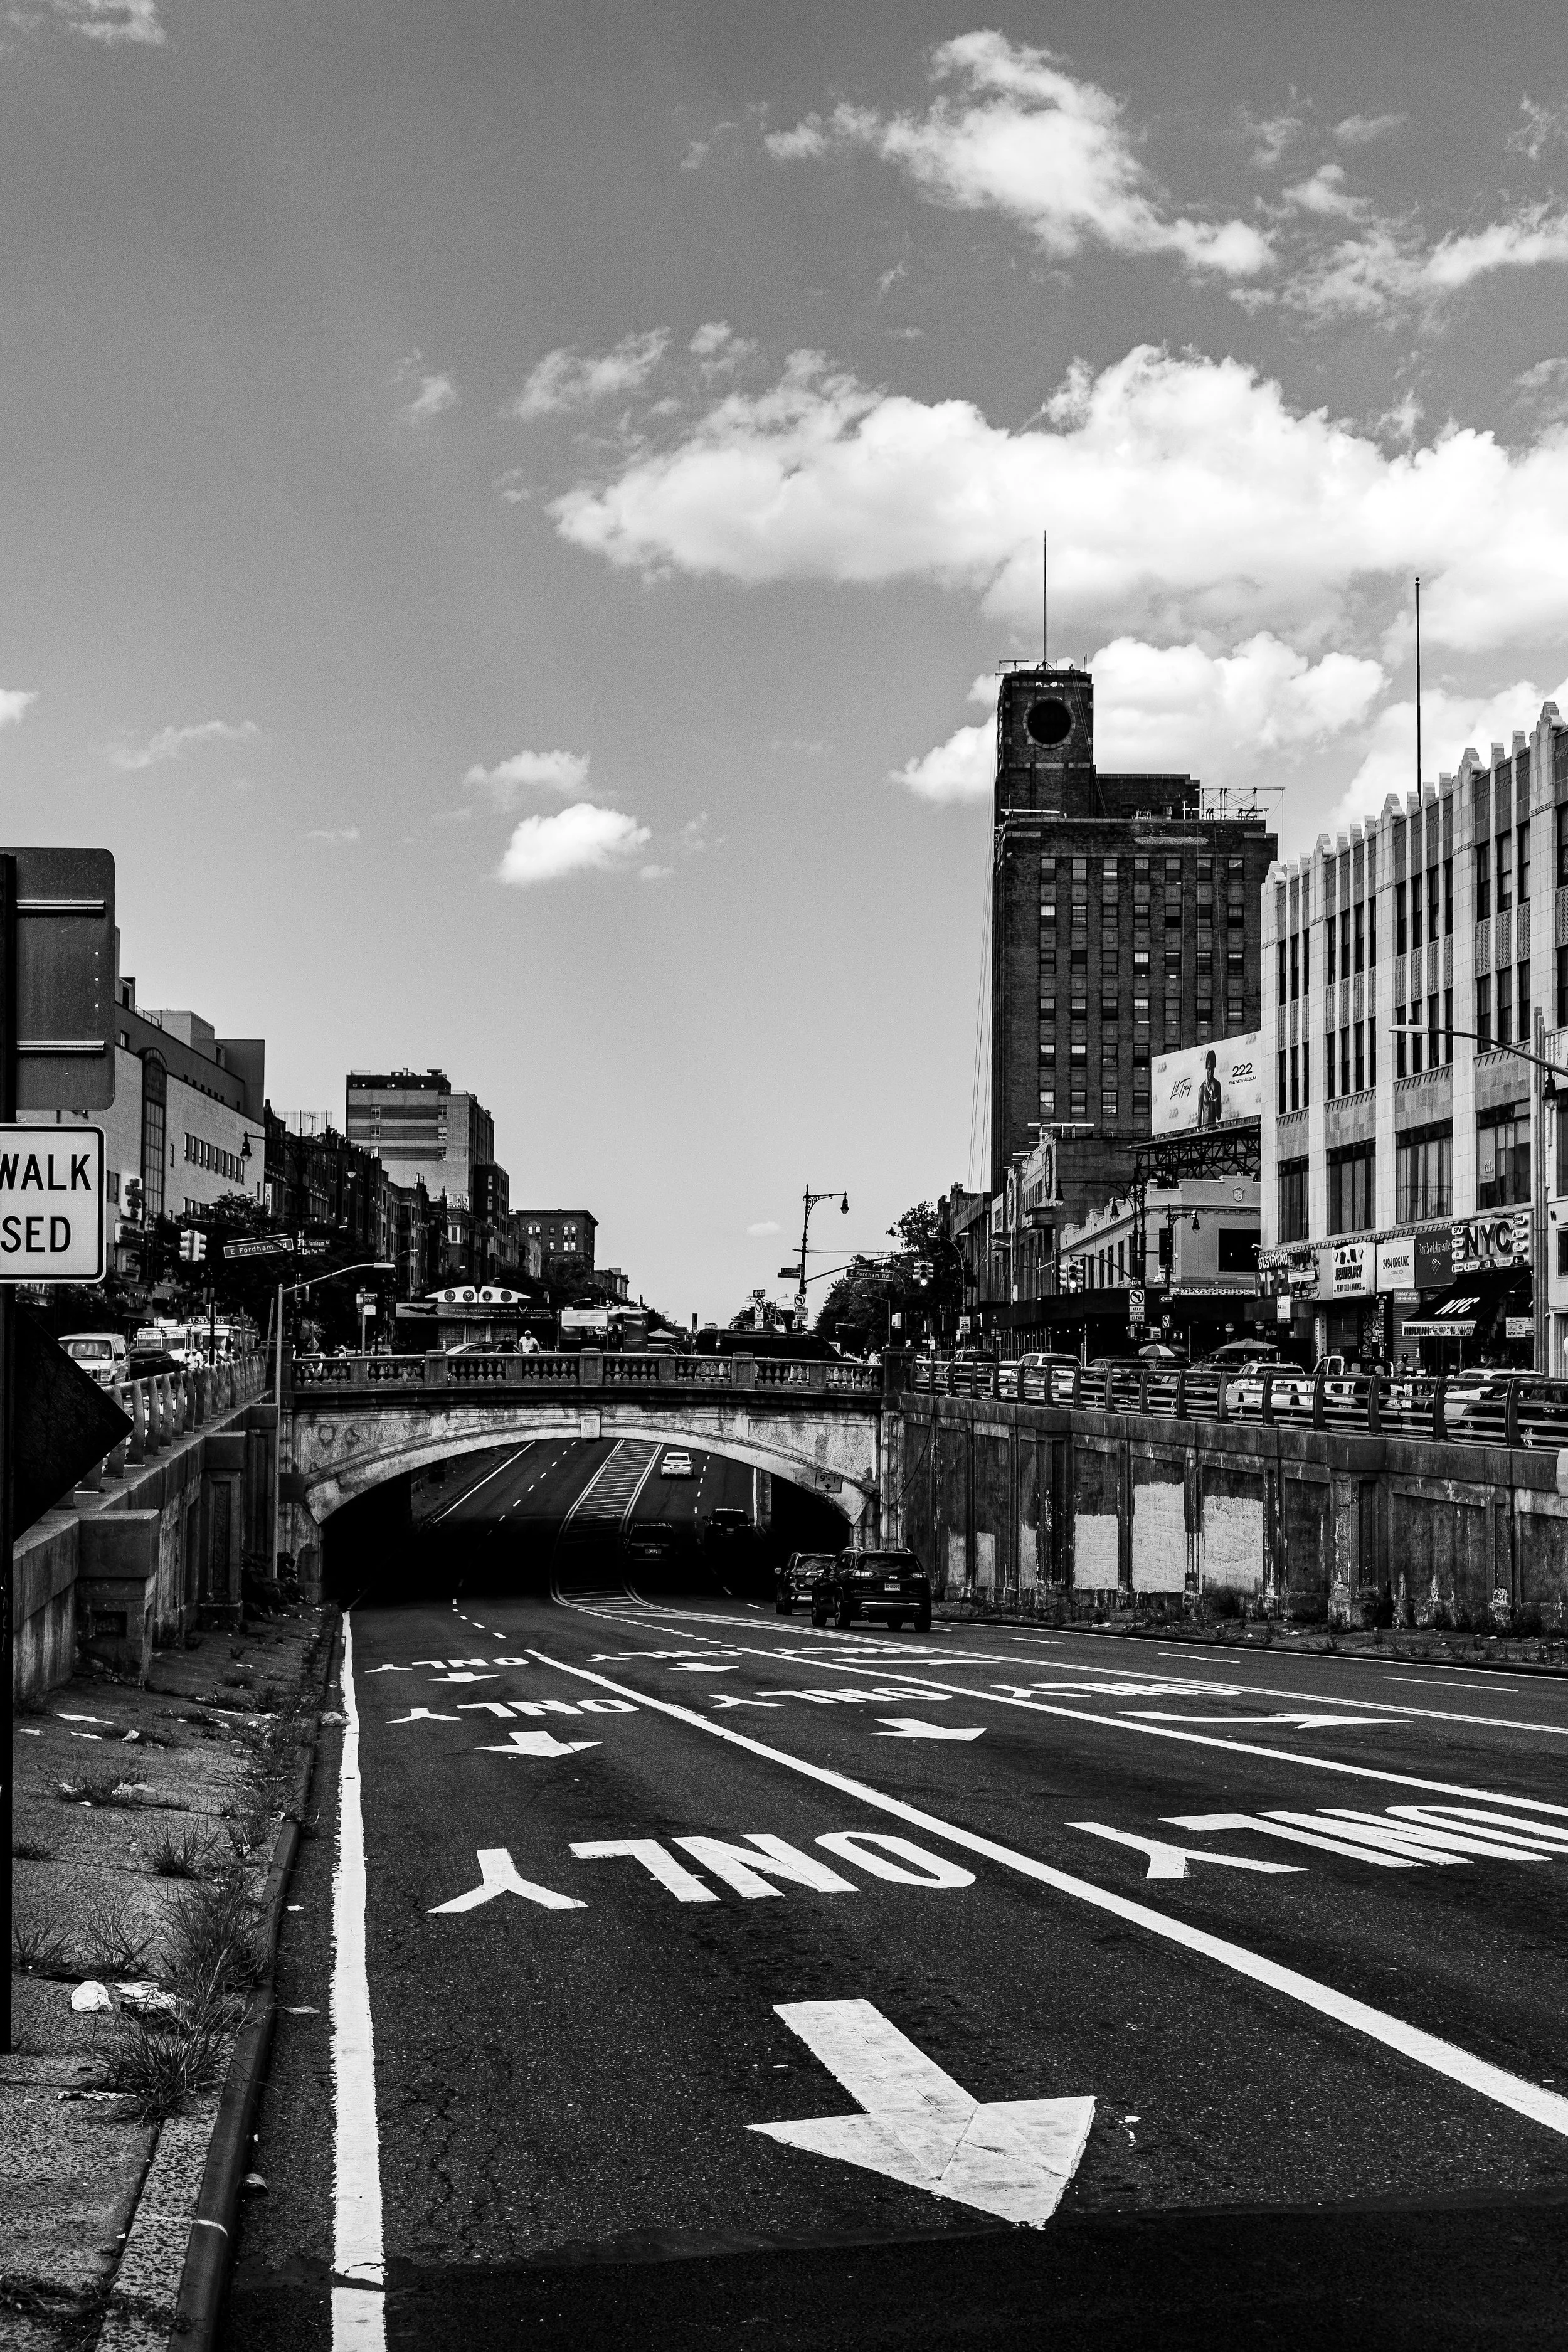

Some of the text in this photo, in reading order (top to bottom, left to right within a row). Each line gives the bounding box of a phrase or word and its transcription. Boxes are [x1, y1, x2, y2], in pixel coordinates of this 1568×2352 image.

[1232, 1062, 1253, 1078] 222
[0, 1153, 92, 1190] WALK
[0, 1216, 71, 1253] SED
[1465, 1221, 1513, 1257] NYC
[239, 1244, 273, 1253] Fordham
[1434, 1239, 1453, 1253] Americ
[1393, 1256, 1409, 1268] ORGANIC
[1335, 1264, 1363, 1281] JEWELRY
[1434, 1297, 1480, 1314] NYC
[585, 1651, 743, 1662] ONLY
[365, 1658, 529, 1673] ONLY
[708, 1687, 953, 1708] ONLY
[990, 1682, 1243, 1698] ONLY
[386, 1699, 640, 1724] ONLY
[1064, 1805, 1568, 1879] ONLY
[426, 1831, 977, 1914] ONLY
